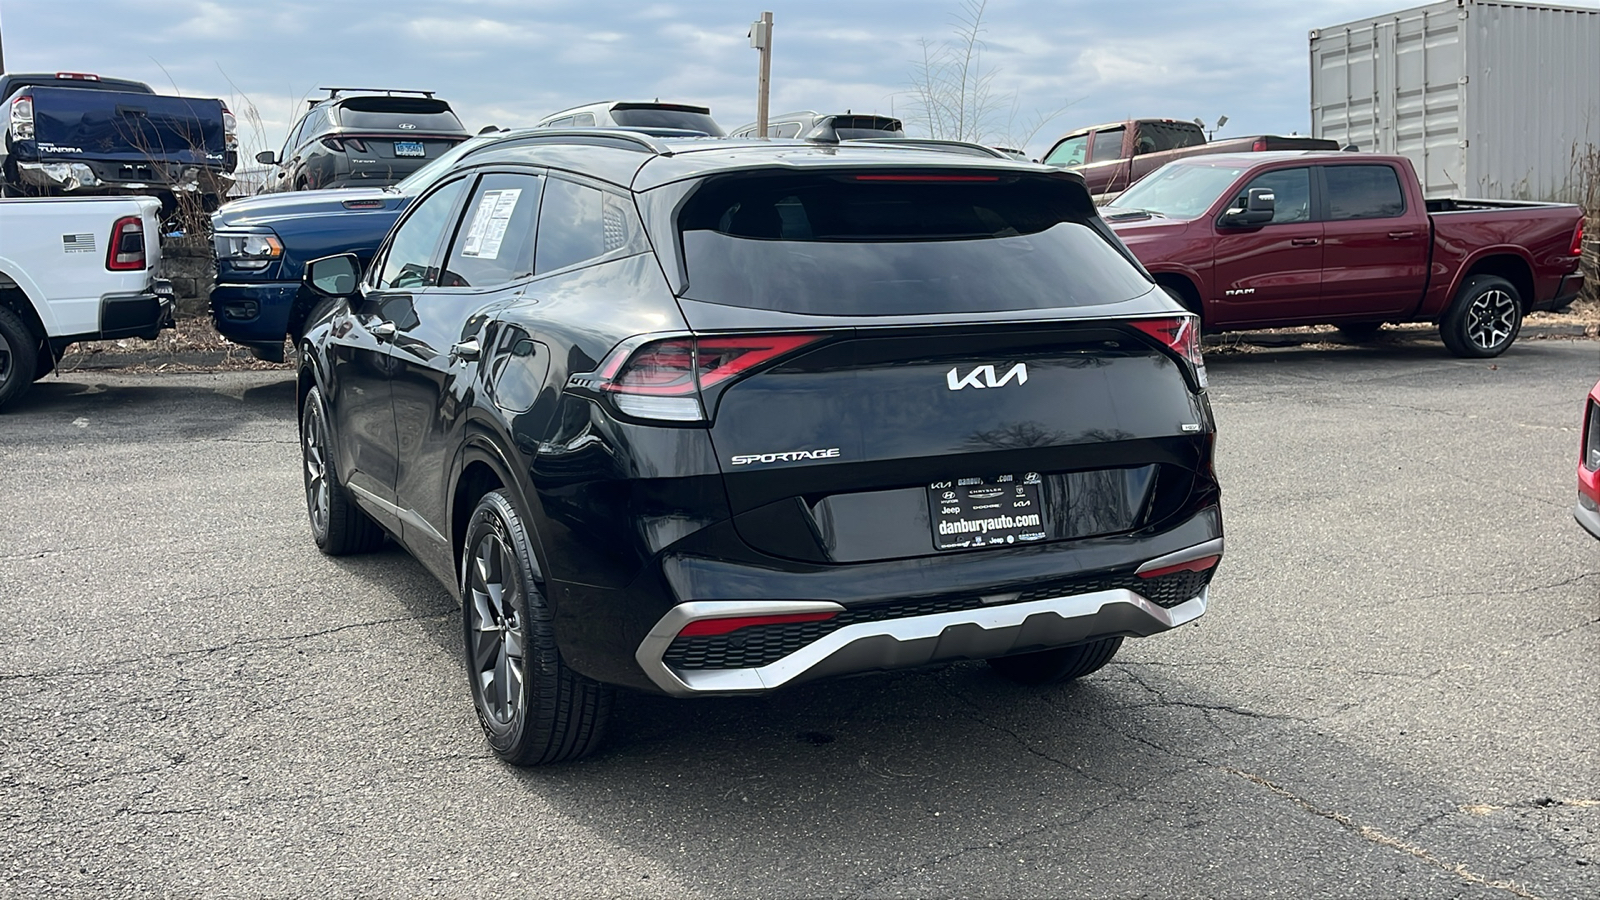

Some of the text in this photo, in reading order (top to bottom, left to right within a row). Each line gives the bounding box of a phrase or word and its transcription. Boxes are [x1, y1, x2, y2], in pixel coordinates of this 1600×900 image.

[1225, 288, 1255, 296] RAM
[947, 363, 1028, 391] KIA
[731, 448, 841, 465] SPORTAGE
[941, 506, 961, 515] Jeep
[939, 513, 1040, 535] danburyauto.com
